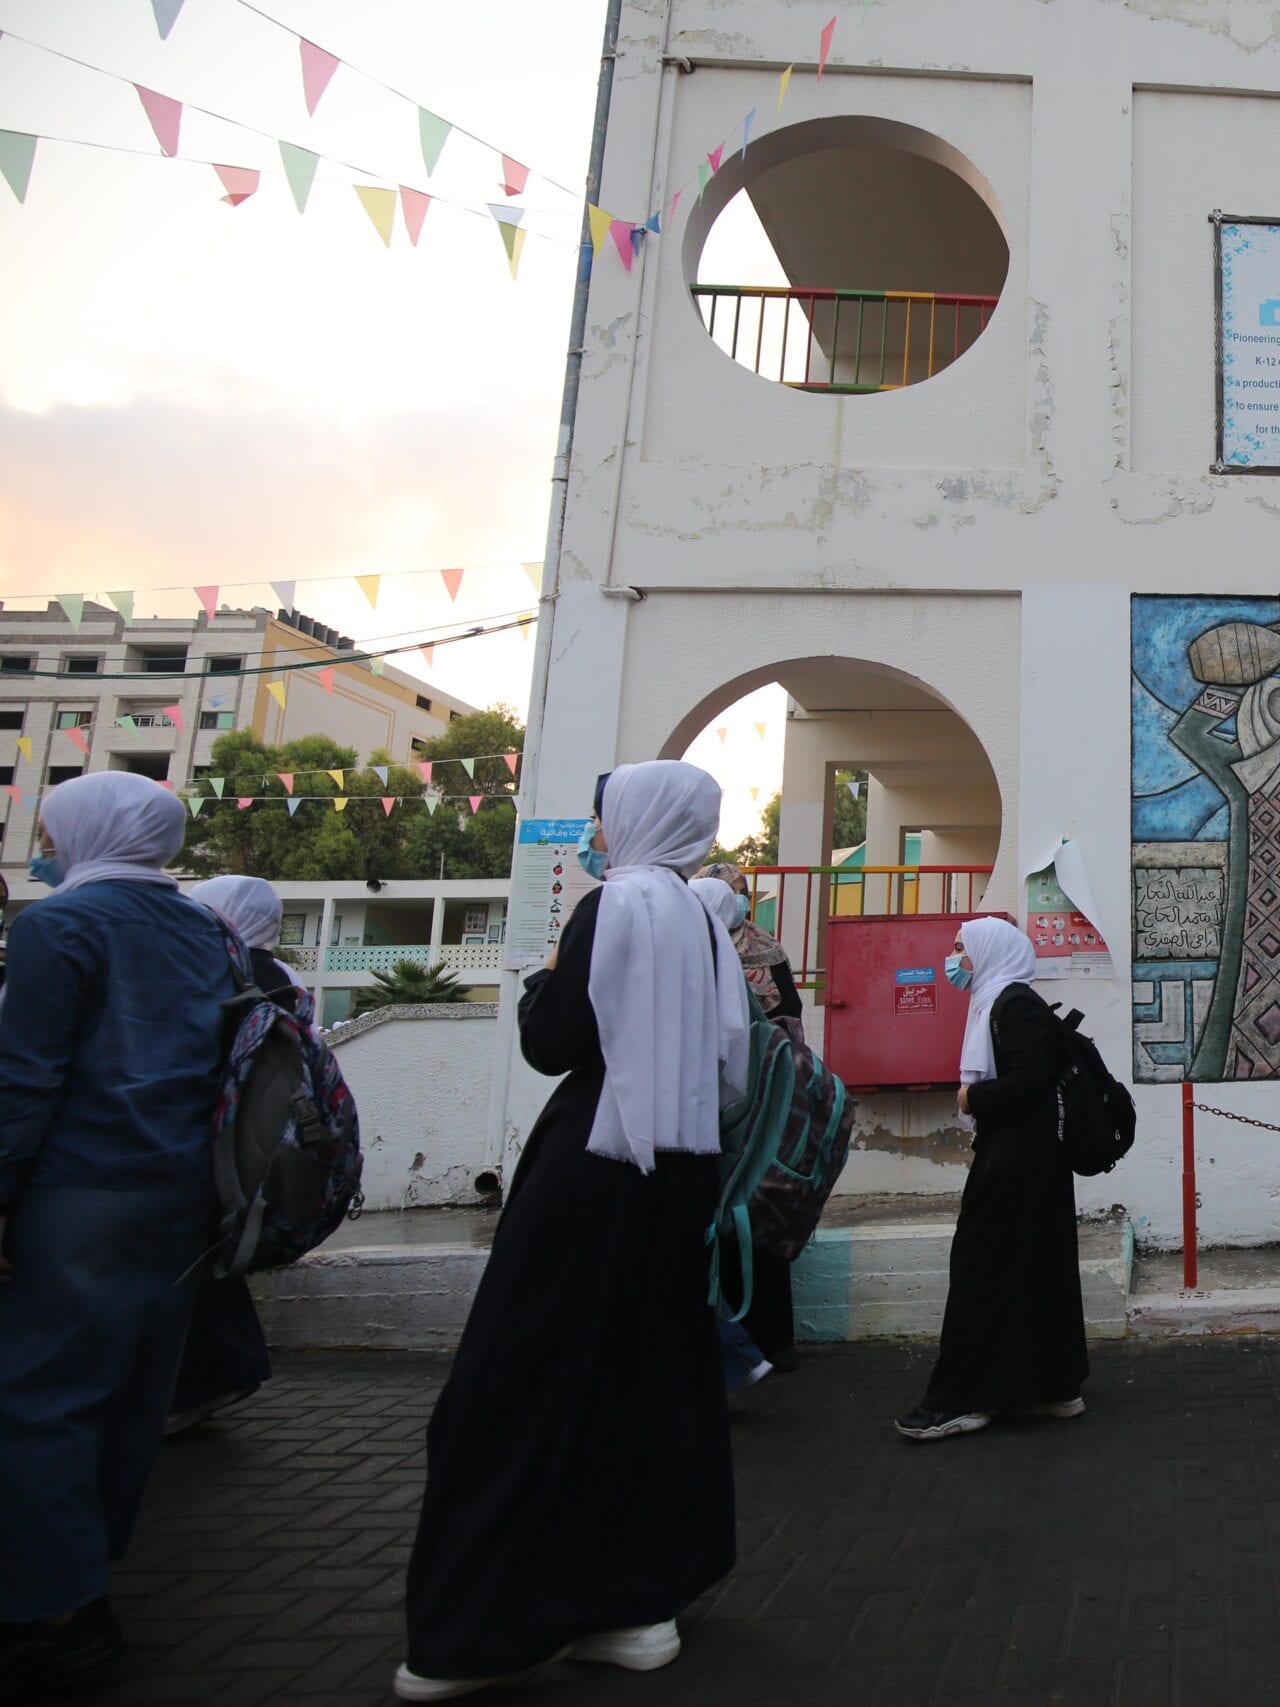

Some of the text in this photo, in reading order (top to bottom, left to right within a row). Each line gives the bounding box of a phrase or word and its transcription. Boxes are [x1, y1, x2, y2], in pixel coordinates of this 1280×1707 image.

[1255, 357, 1276, 366] K-12
[1236, 402, 1245, 410] to
[1247, 403, 1279, 411] ensure
[1256, 425, 1268, 434] for
[903, 986, 927, 997] حريق
